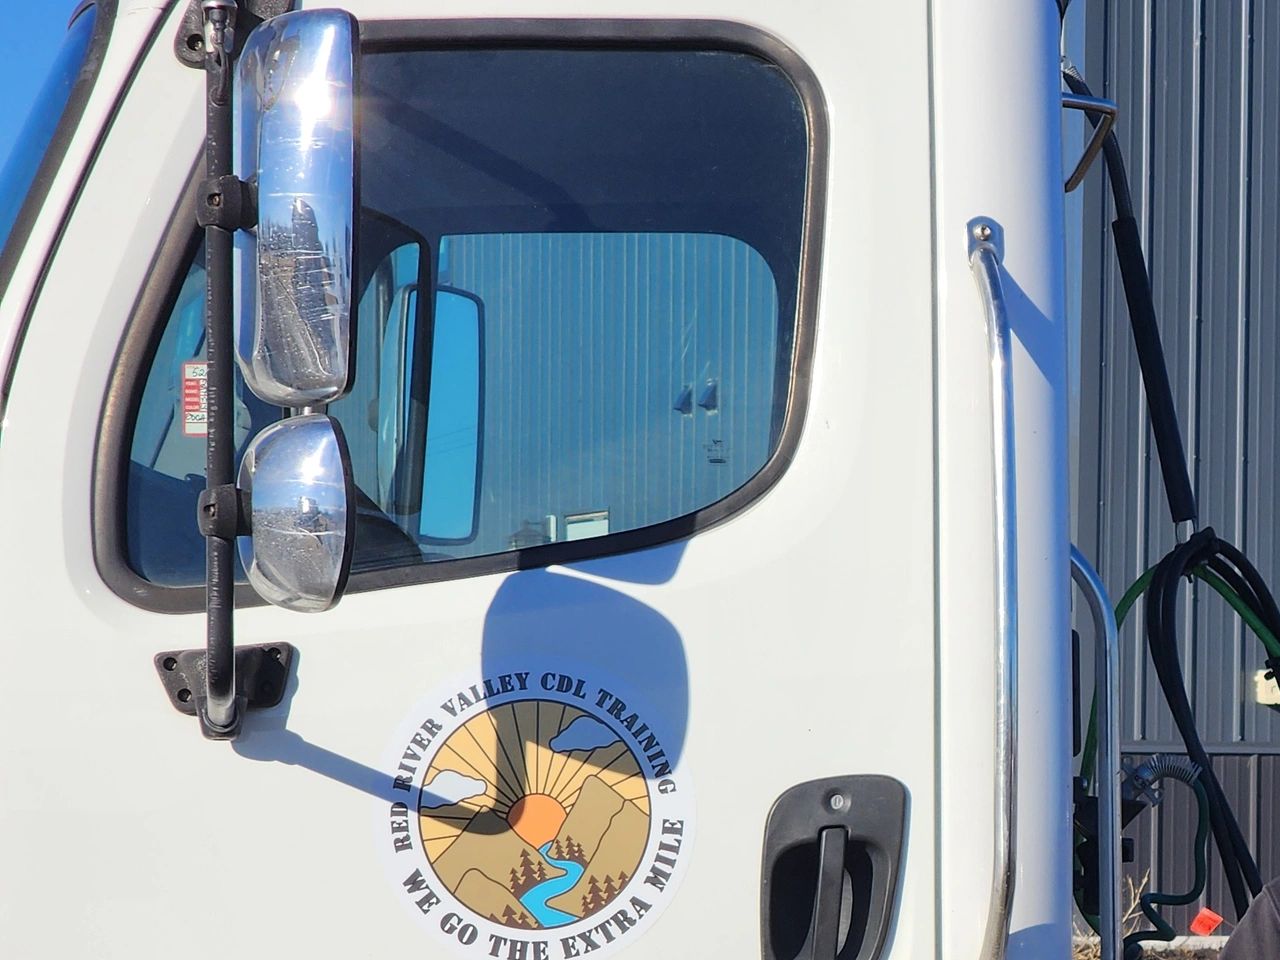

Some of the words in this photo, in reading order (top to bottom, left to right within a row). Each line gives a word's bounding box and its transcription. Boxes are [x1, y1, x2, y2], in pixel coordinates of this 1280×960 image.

[440, 671, 530, 718] VALLEY
[540, 672, 587, 699] CDL
[393, 718, 443, 792] RIVER
[597, 688, 677, 795] TRAINING
[390, 801, 413, 853] RED
[402, 868, 433, 914] WE
[439, 912, 478, 946] GO
[560, 895, 652, 960] EXTRA
[644, 818, 684, 893] MILE
